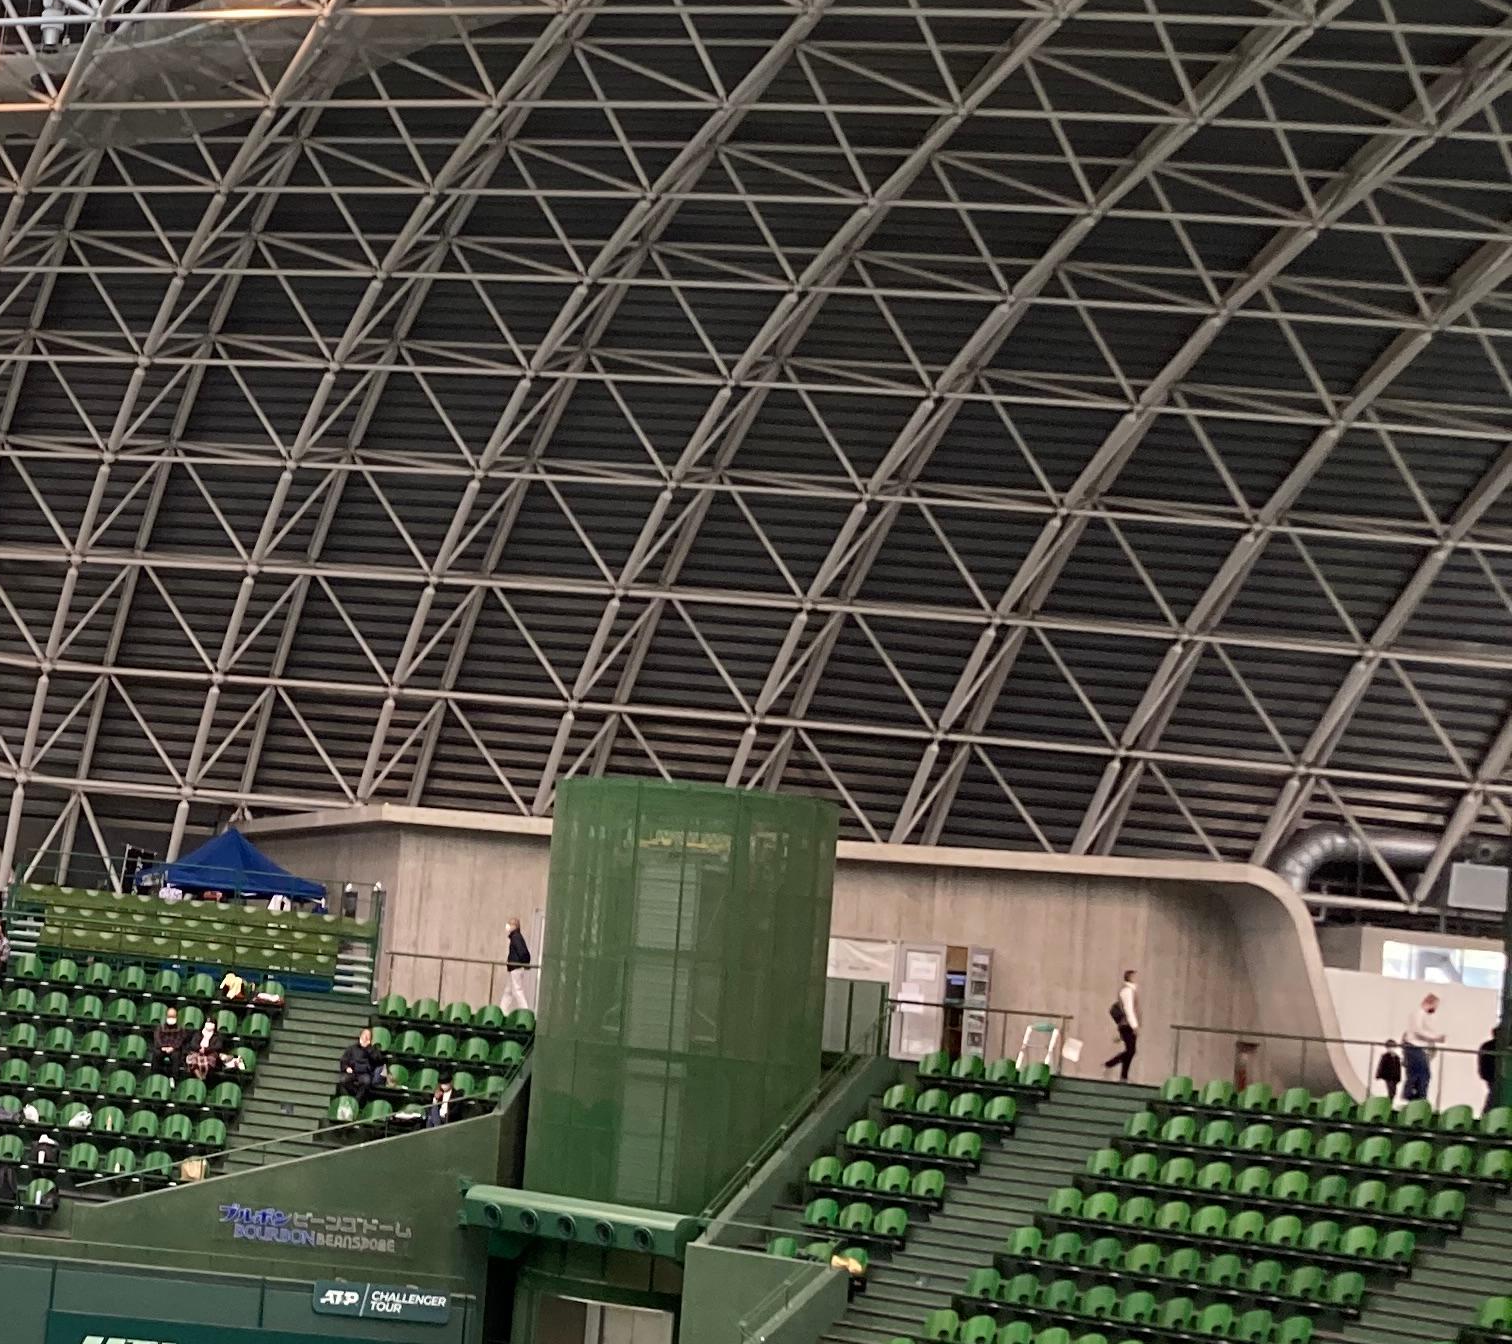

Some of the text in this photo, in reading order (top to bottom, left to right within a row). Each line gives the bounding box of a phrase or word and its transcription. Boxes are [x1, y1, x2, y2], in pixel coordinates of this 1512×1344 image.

[320, 1289, 446, 1308] ATP CHALLENGER
[370, 1301, 402, 1314] TOUR
